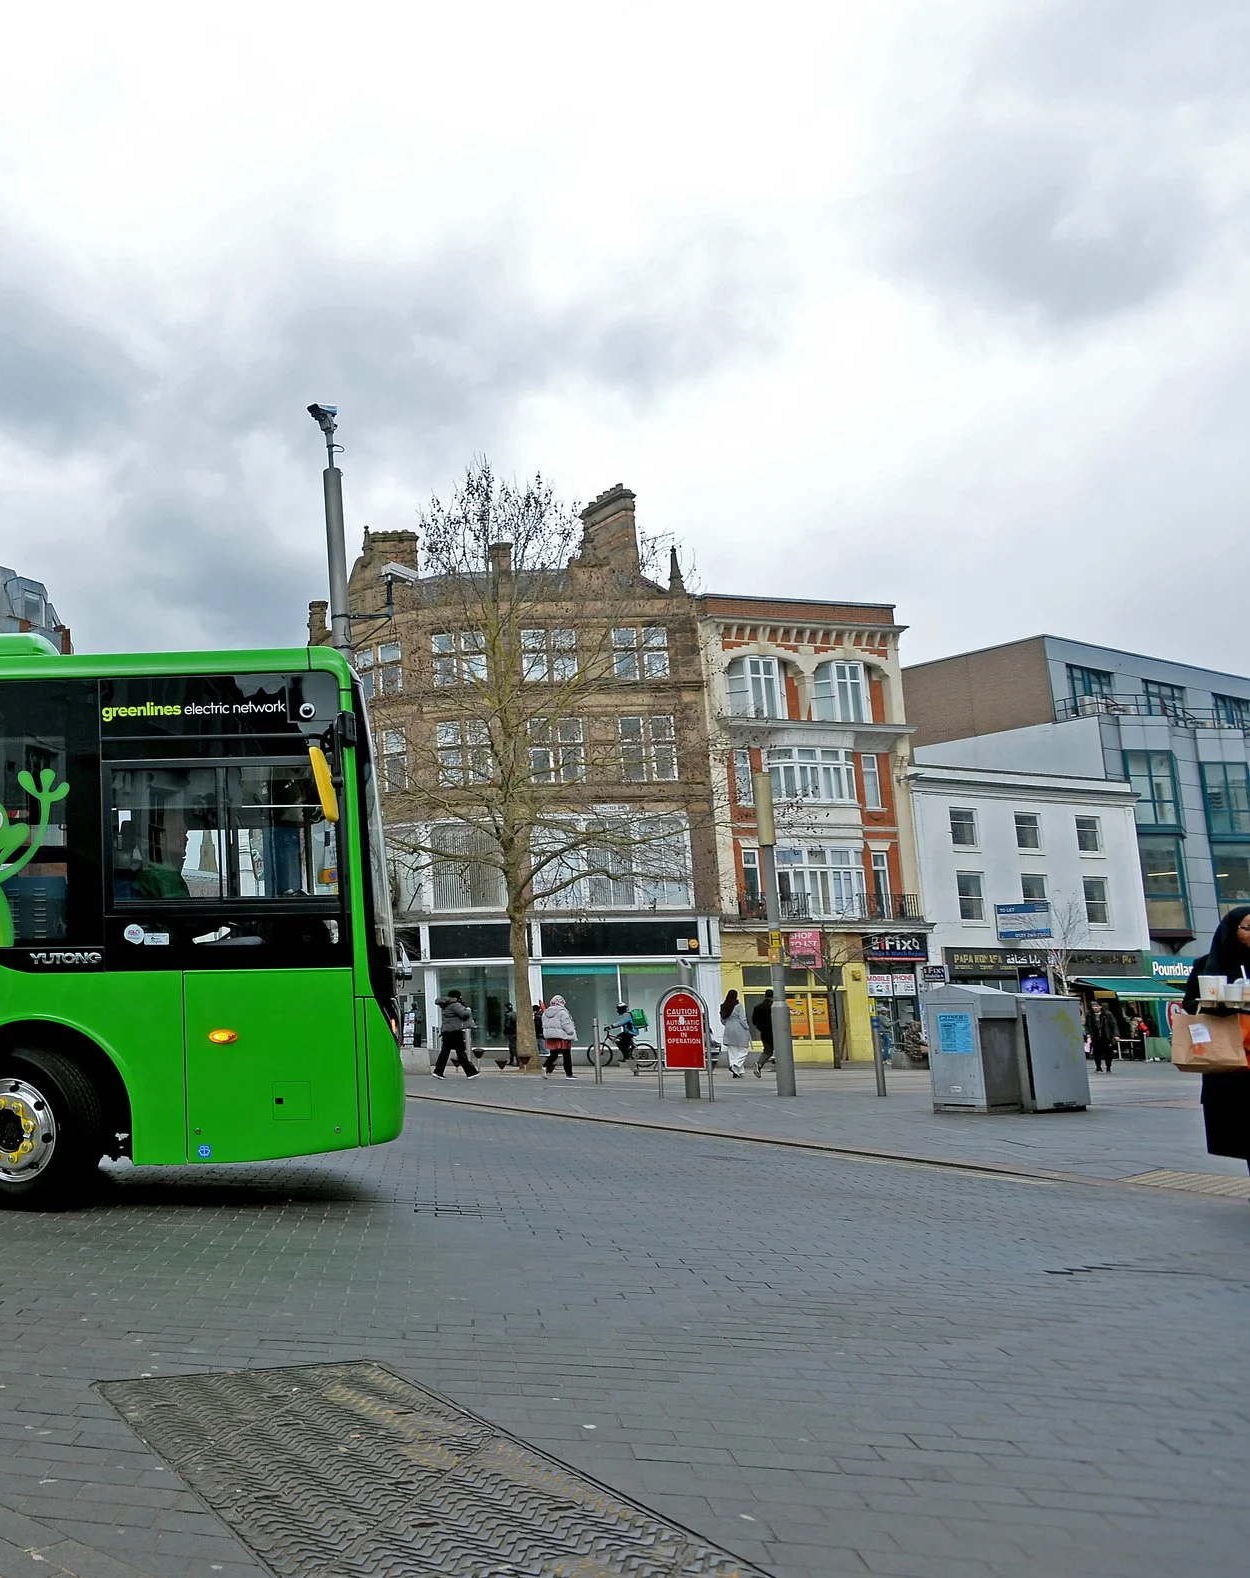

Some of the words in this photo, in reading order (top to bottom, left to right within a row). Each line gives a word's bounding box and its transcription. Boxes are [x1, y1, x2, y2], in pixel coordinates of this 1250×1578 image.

[101, 701, 182, 722] greenlines
[183, 702, 230, 715] electric
[232, 700, 287, 714] network
[790, 932, 813, 940] SHOP
[29, 951, 103, 965] YUTONG
[953, 954, 974, 964] PAPA
[1152, 961, 1194, 976] Poundla
